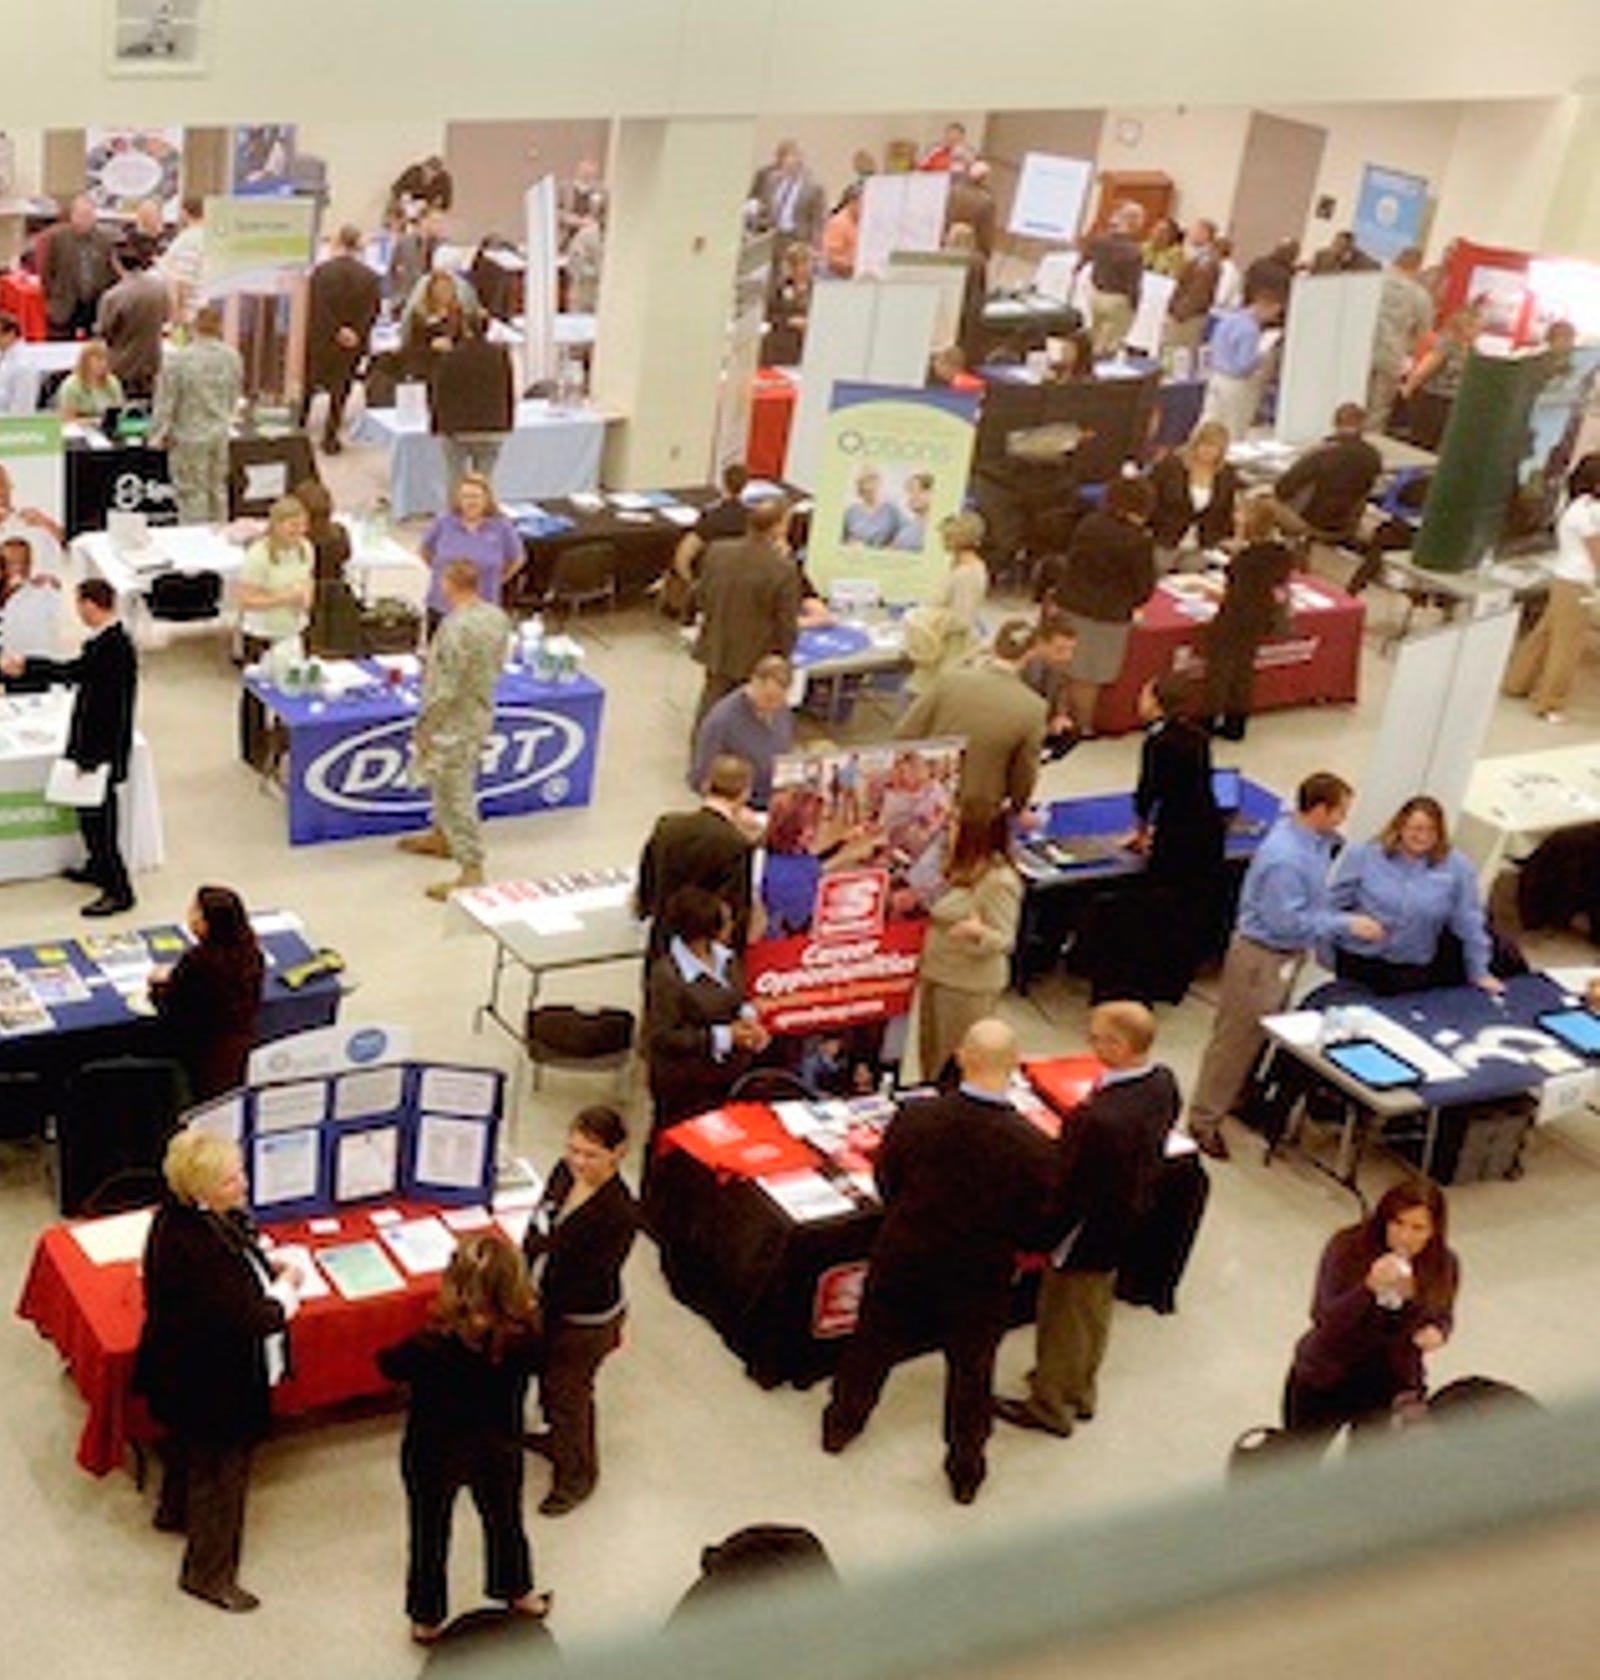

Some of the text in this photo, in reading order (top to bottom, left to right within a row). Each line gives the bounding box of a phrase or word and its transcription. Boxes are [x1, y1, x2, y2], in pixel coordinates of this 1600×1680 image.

[341, 726, 555, 794] DRT
[802, 940, 880, 965] Career
[755, 954, 917, 997] Opportunities
